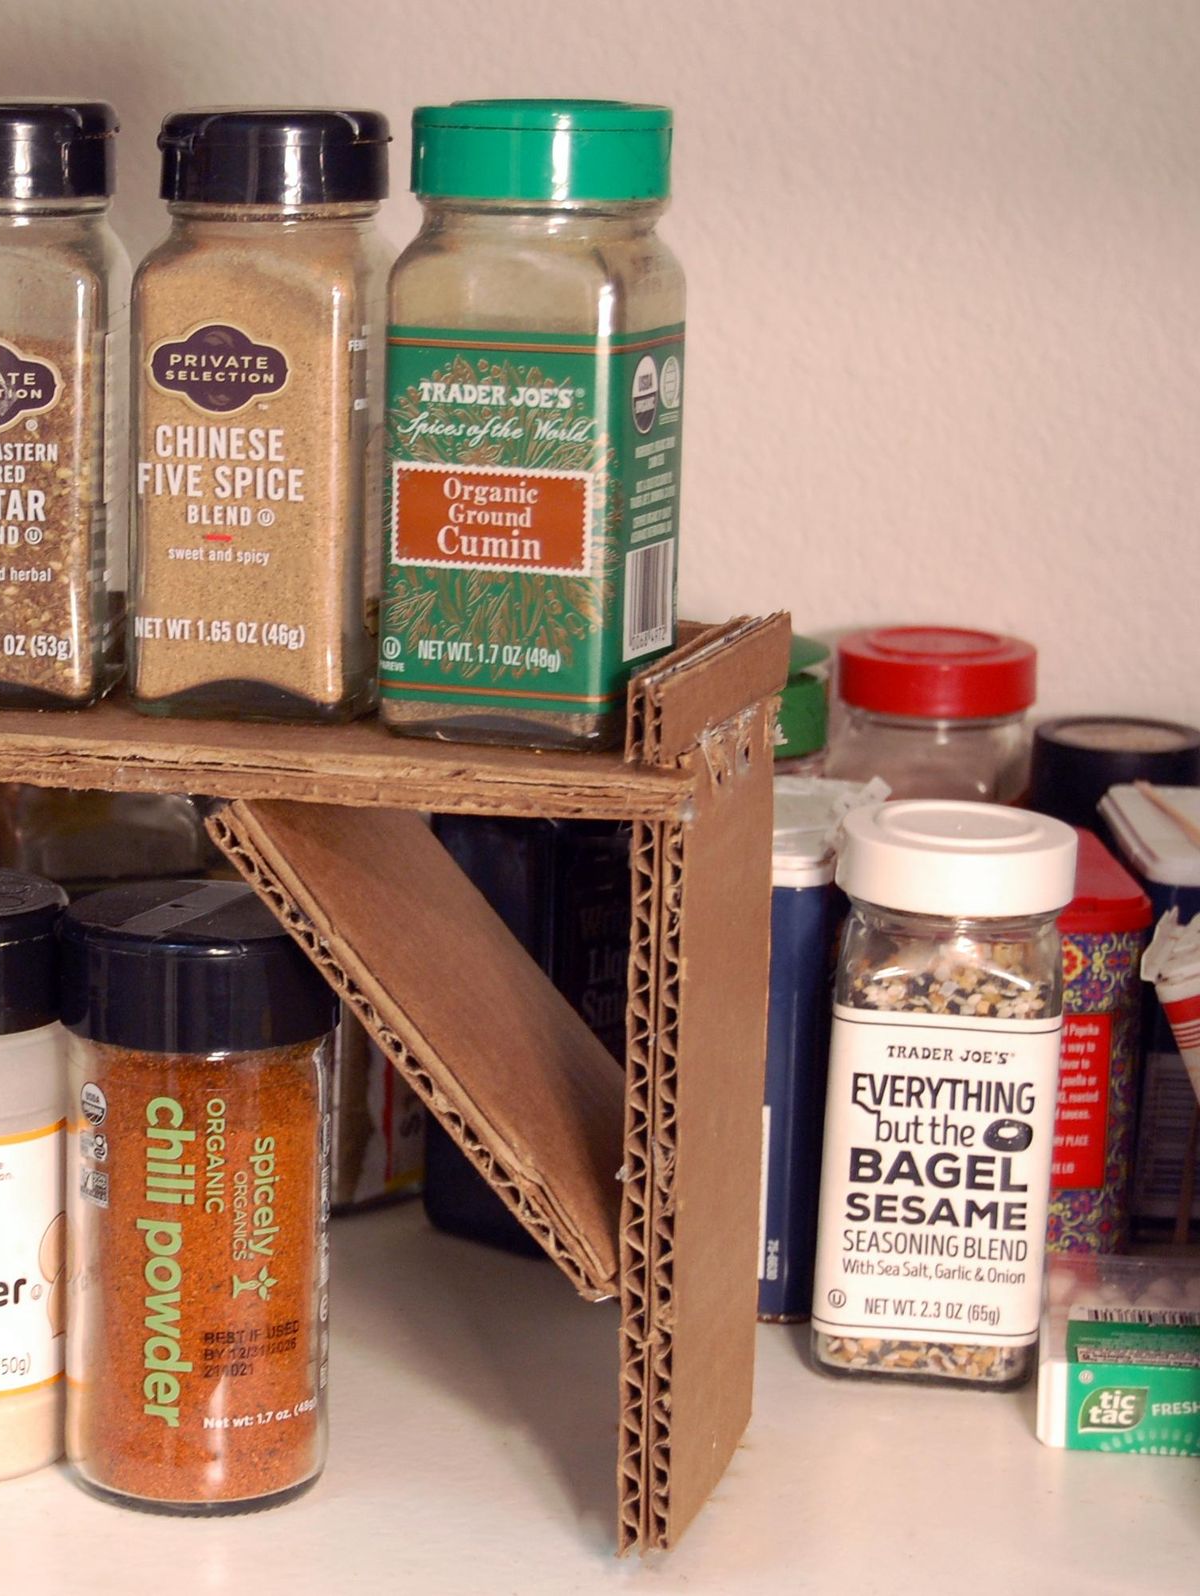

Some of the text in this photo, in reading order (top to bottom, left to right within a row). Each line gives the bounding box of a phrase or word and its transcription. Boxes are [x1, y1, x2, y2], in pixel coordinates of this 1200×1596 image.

[169, 353, 268, 370] PRIVATE
[165, 370, 275, 384] SELECTION
[420, 382, 574, 409] TRADER JOE'S
[397, 412, 465, 443] Spices
[532, 418, 598, 443] World
[155, 424, 285, 462] CHINESE
[137, 461, 304, 502] FIVE SPICE
[443, 476, 538, 506] Organic
[187, 505, 252, 526] BLEND
[448, 503, 532, 528] Ground
[168, 547, 270, 565] sweet and spicy
[437, 526, 542, 561] Cumin
[10, 566, 52, 582] herbal
[134, 616, 306, 649] NET WT 1.65 OZ (46g)
[4, 634, 25, 656] OZ
[30, 636, 74, 661] (53g)
[418, 639, 561, 673] NET WT. 1.7 OZ (48g)
[886, 1045, 1010, 1065] TRADER JOE'S
[851, 1072, 1036, 1115] EVERYTHING
[874, 1113, 975, 1148] but the
[205, 1098, 226, 1214] ORGANIC
[849, 1147, 1029, 1192] BAGEL
[249, 1136, 281, 1256] spicely
[232, 1171, 249, 1261] ORGANICS
[845, 1192, 1028, 1231] SESAME
[842, 1229, 1028, 1262] SEASONING BLEND
[136, 1096, 196, 1427] chili powder
[842, 1258, 1026, 1284] With Sea Salt, Garlic & Onion
[864, 1297, 1001, 1326] NET WT. 2.3 OZ (65g)
[204, 1330, 245, 1344] BEST
[204, 1349, 224, 1360] BY
[1099, 1390, 1137, 1410] tic
[203, 1417, 228, 1429] Net
[256, 1411, 273, 1424] 1.7
[1089, 1406, 1135, 1424] tac
